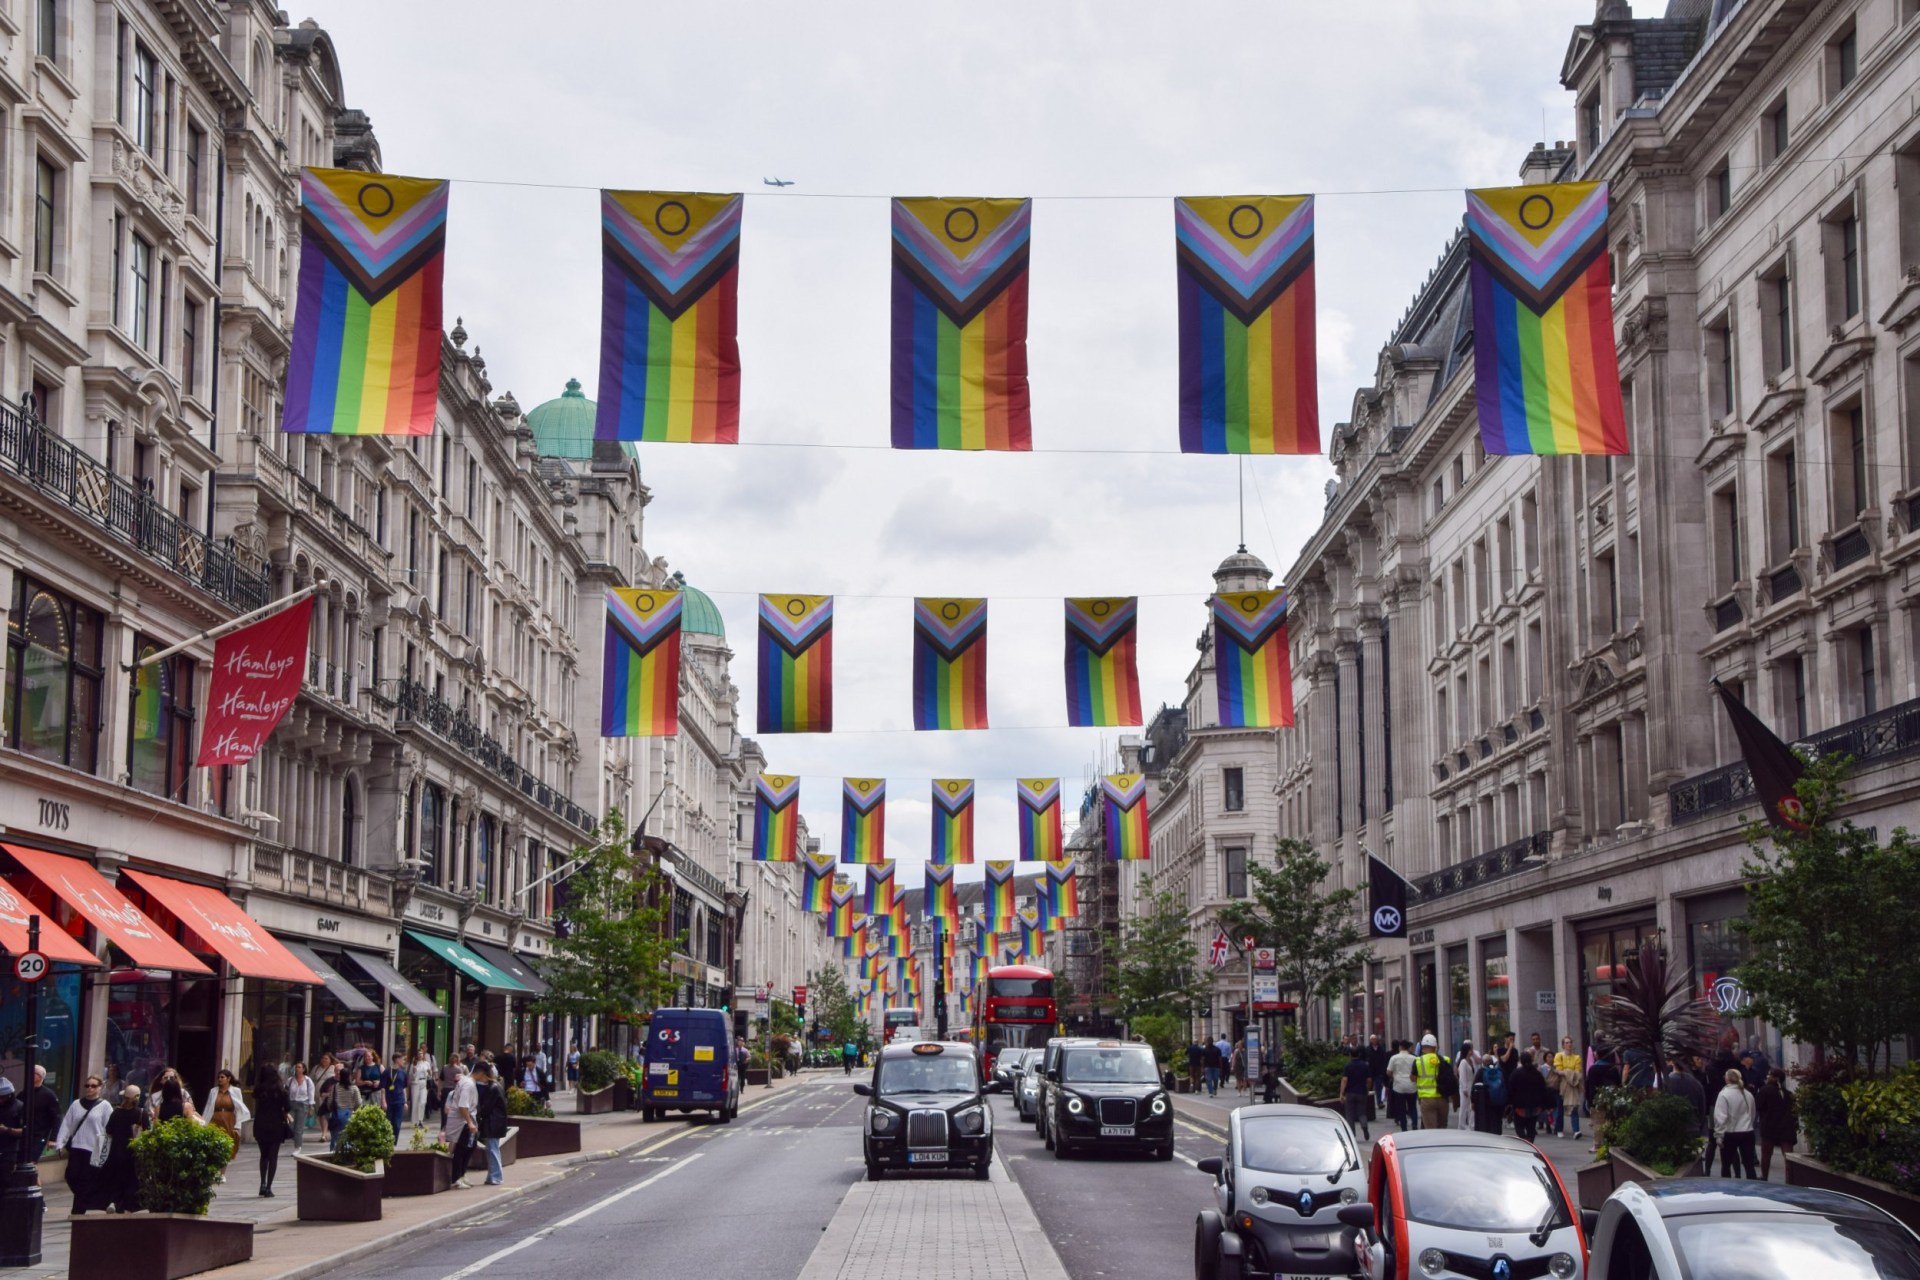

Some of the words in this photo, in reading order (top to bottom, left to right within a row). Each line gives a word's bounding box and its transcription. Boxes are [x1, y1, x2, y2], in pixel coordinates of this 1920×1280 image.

[223, 645, 294, 680] Hamleys
[218, 685, 289, 721] Hamleys
[38, 798, 70, 831] TOYS
[317, 918, 340, 932] GANT
[1378, 912, 1398, 926] MK
[1244, 938, 1255, 947] M
[20, 959, 44, 973] 20
[658, 1028, 681, 1043] G4S
